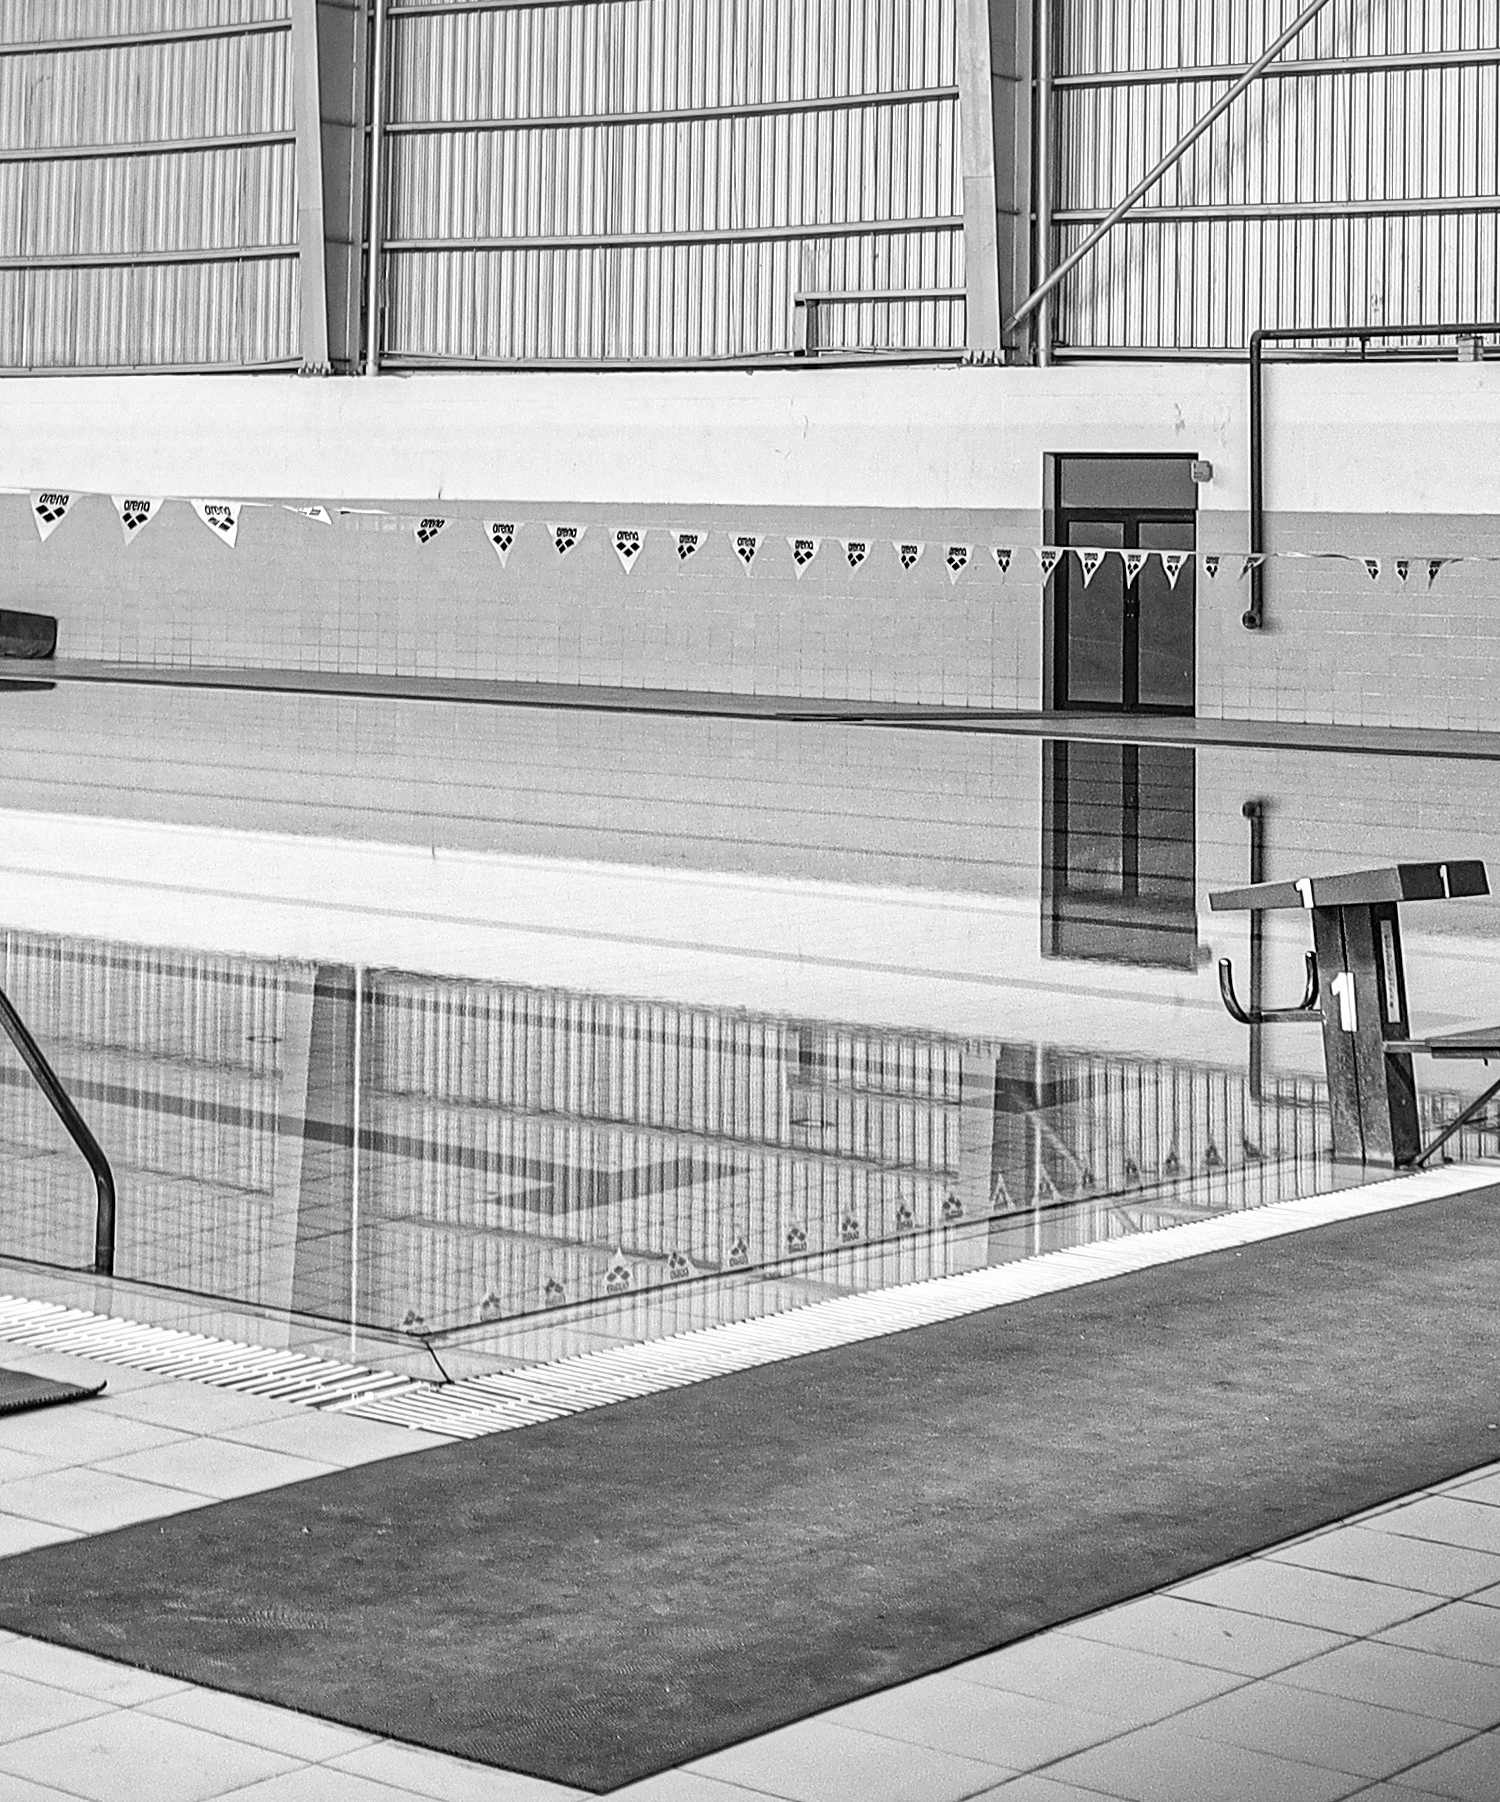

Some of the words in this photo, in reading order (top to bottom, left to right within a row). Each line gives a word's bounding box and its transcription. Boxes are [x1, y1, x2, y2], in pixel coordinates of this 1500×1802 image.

[39, 493, 69, 505] arena
[124, 499, 150, 512] arena
[204, 504, 231, 516] arena
[492, 523, 515, 535] arena
[617, 531, 639, 541] arena
[1440, 864, 1450, 898] 1
[1295, 877, 1314, 908] 1
[1331, 972, 1357, 1032] 1
